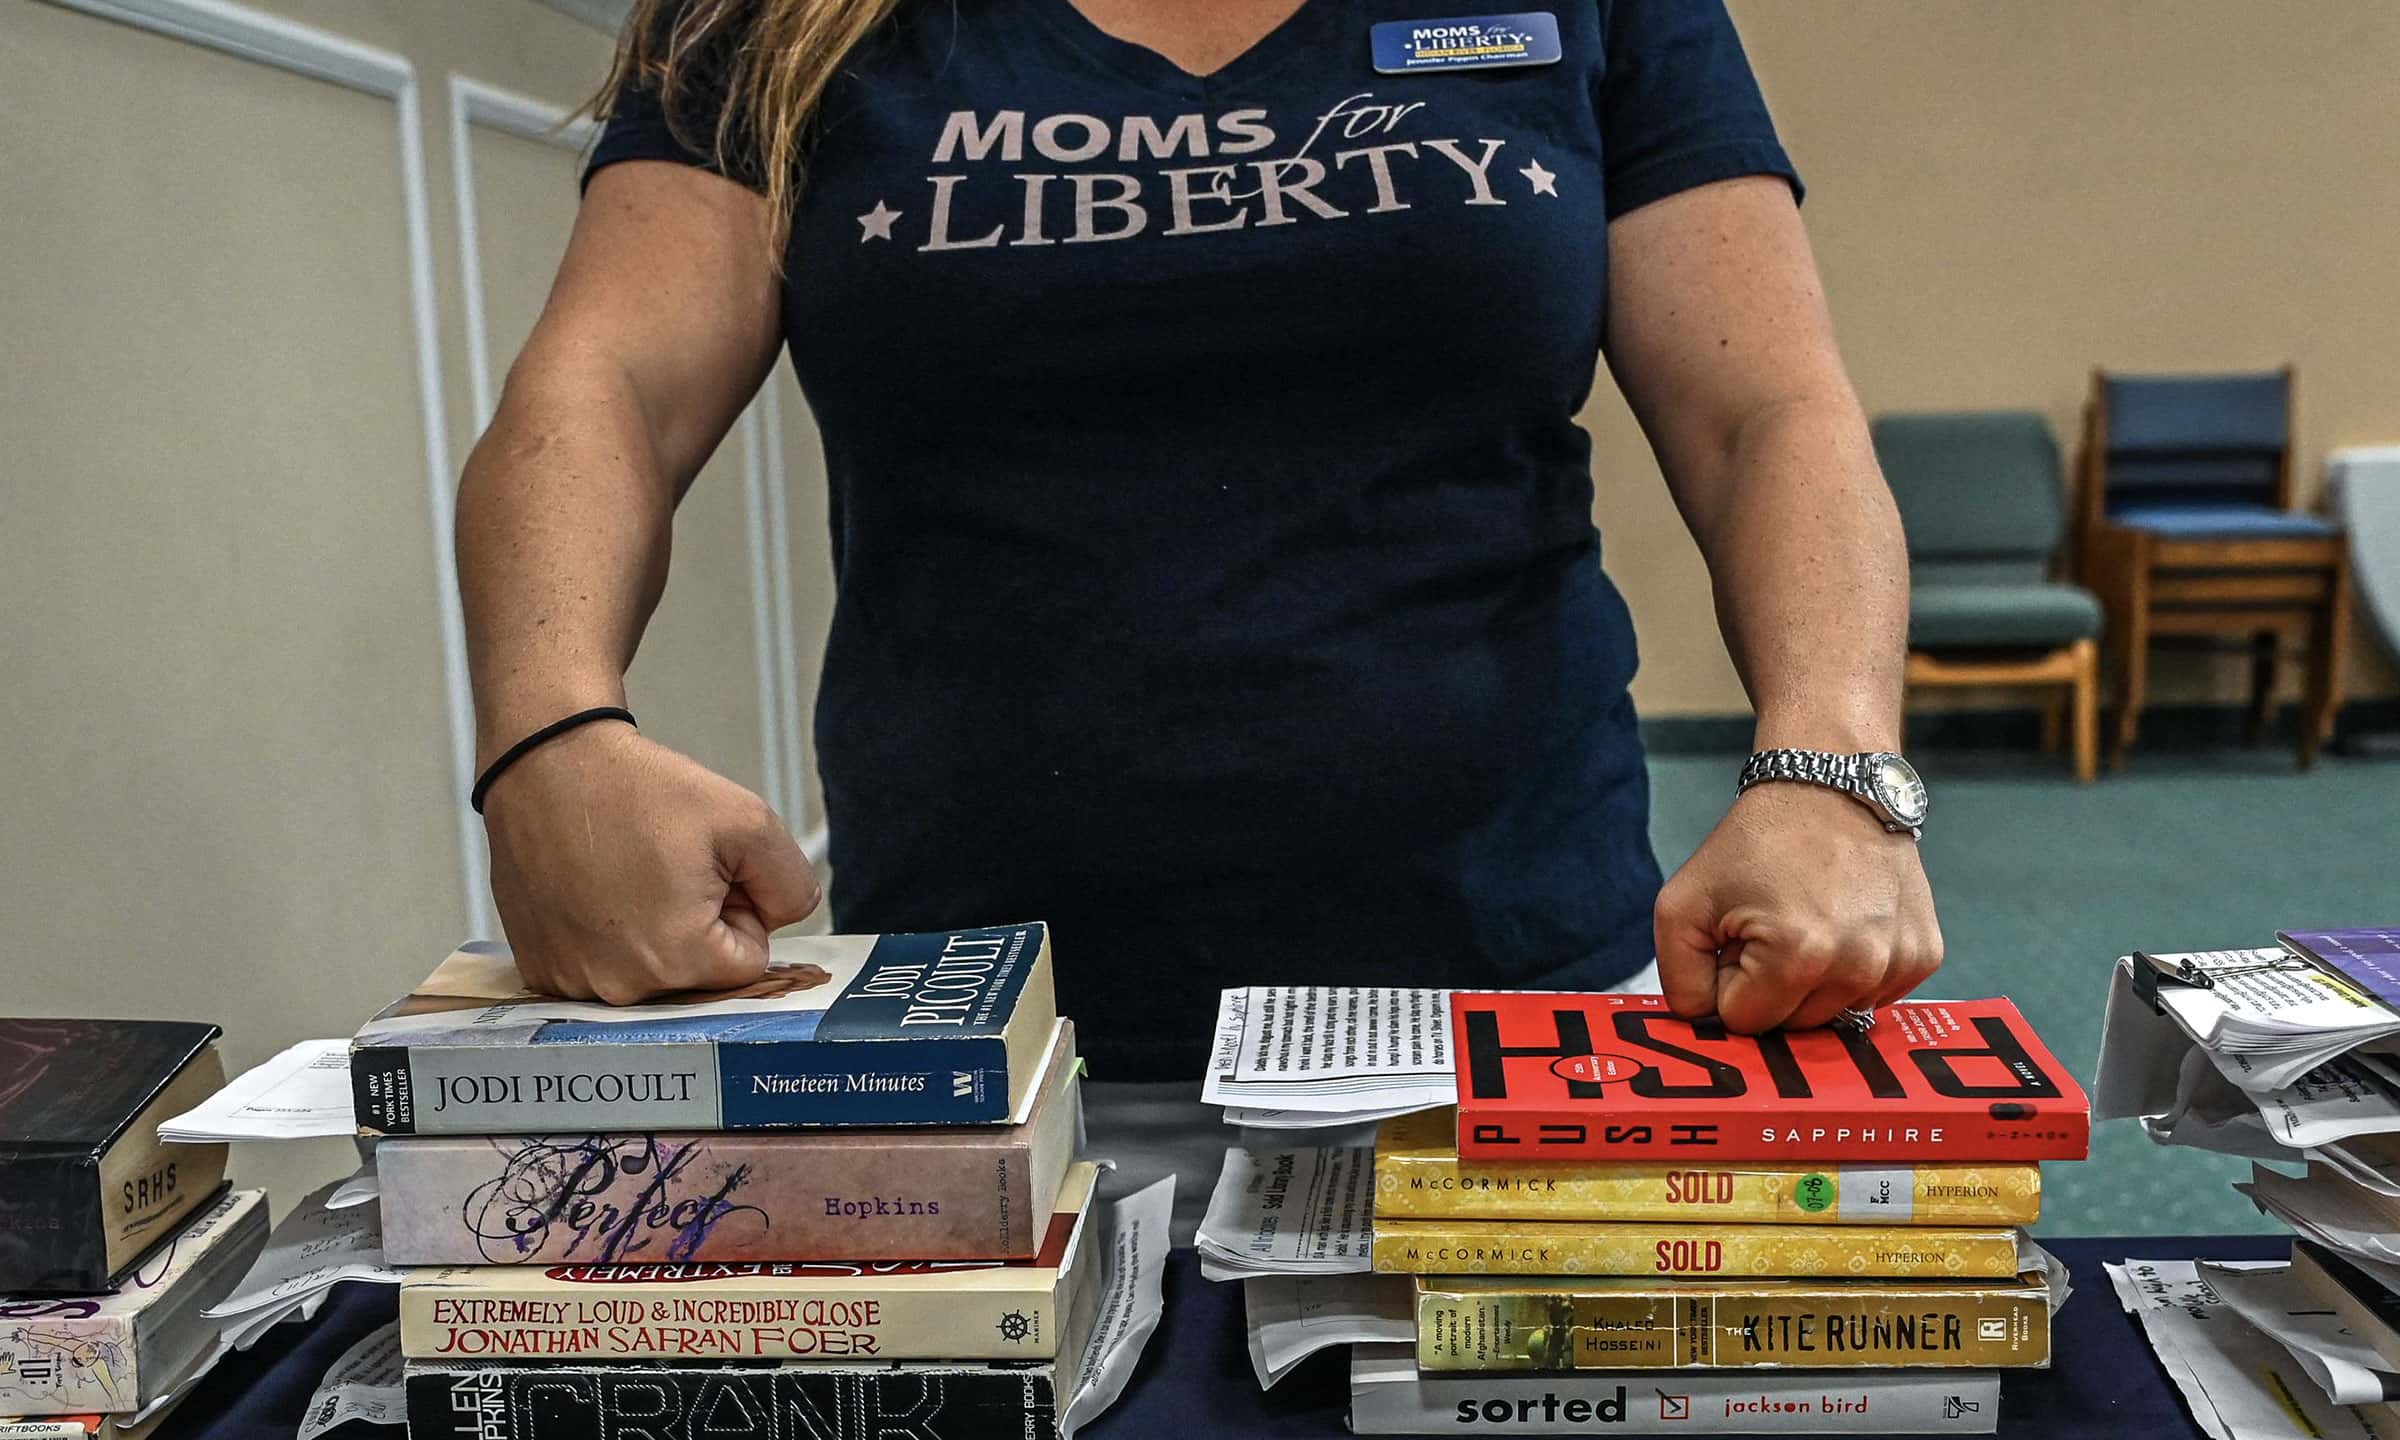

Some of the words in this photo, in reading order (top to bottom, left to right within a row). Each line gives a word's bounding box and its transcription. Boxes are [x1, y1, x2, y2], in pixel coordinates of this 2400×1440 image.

[1413, 25, 1480, 40] MOMS
[1416, 33, 1525, 50] LIBERTY
[1406, 57, 1445, 66] Jennifer
[1448, 55, 1479, 63] Pippin
[1481, 52, 1528, 61] Chairman
[931, 109, 1276, 161] MOMS
[1262, 93, 1425, 175] for
[917, 138, 1506, 252] LIBERTY
[1004, 930, 1027, 962] BESTSELLER
[847, 963, 928, 1000] JODI
[900, 935, 1005, 1027] PICOULT
[371, 1073, 379, 1097] NEW
[383, 1071, 392, 1099] TIMES
[397, 1068, 410, 1123] BESTSELLER
[434, 1076, 520, 1111] JODI
[533, 1073, 696, 1103] PICOULT
[752, 1074, 840, 1094] Nineteen
[845, 1074, 925, 1093] Minutes
[372, 1104, 380, 1115] #1
[386, 1100, 395, 1127] YORK
[1473, 1125, 1719, 1145] PUSH
[1762, 1127, 1945, 1144] SAPPHIRE
[123, 1162, 177, 1215] SRHS
[1410, 1178, 1556, 1191] McCORMICK
[1666, 1170, 1734, 1204] SOLD
[1804, 1178, 1824, 1210] 07-08
[1870, 1196, 1879, 1205] F
[1879, 1180, 1890, 1205] MCC
[1927, 1185, 1999, 1198] HYPERION
[825, 1198, 940, 1218] Hopkins
[1407, 1249, 1549, 1261] McCORMICK
[1655, 1240, 1722, 1272] SOLD
[1876, 1252, 1946, 1264] HYPERION
[433, 1299, 571, 1325] EXTREMELY
[578, 1302, 644, 1325] LOUD
[651, 1301, 670, 1321] &
[674, 1299, 799, 1324] INCREDIBLY
[803, 1300, 881, 1327] CLOSE
[1436, 1310, 1444, 1338] moving
[1450, 1309, 1457, 1321] of
[435, 1327, 599, 1353] JONATHAN
[608, 1326, 742, 1355] SAFRAN
[751, 1327, 881, 1355] FOER
[1450, 1324, 1458, 1357] portrait
[1701, 1307, 1709, 1356] BESTSELLER
[1725, 1327, 1752, 1336] THE
[1744, 1314, 1815, 1351] KITE
[1826, 1313, 1961, 1351] RUNNER
[2021, 1315, 2029, 1341] BOOKS
[450, 1371, 483, 1440] LEN
[1023, 1374, 1035, 1409] BOOKS
[1456, 1386, 1627, 1423] sorted
[1725, 1395, 1810, 1417] jackson
[1822, 1395, 1868, 1414] bird
